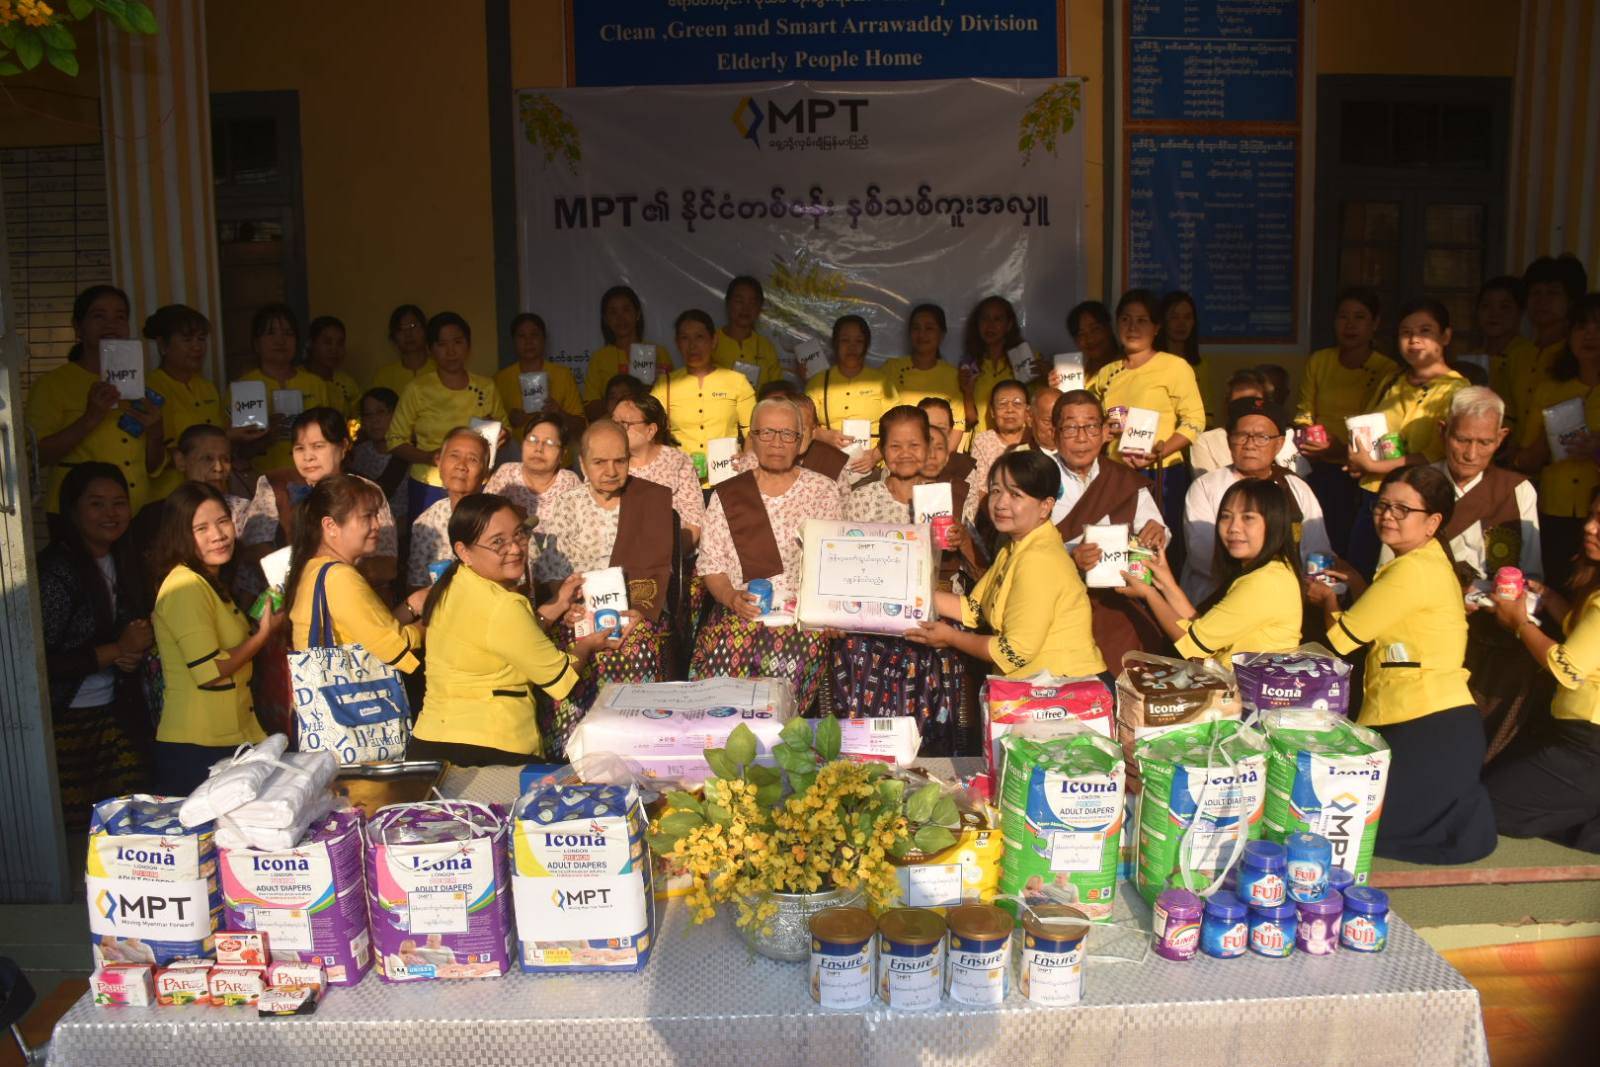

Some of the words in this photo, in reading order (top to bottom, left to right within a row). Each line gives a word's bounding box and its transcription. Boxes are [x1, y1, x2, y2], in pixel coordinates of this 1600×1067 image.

[600, 23, 656, 42] Clean
[734, 18, 769, 37] and
[776, 17, 836, 36] Smart
[843, 14, 954, 37] Arrawaddy
[961, 13, 1039, 31] Division
[717, 50, 786, 73] Elderly
[796, 49, 858, 72] People
[865, 48, 923, 66] Home
[768, 98, 868, 134] MPT
[242, 400, 264, 410] MPT
[1133, 430, 1154, 439] MPT
[1103, 551, 1128, 562] MPT
[596, 592, 620, 605] MPT
[1261, 682, 1302, 698] Icona
[1061, 780, 1118, 794] Icona
[1060, 808, 1083, 816] ADULT
[1085, 807, 1115, 815] DIAPERS
[545, 832, 607, 847] Icona
[117, 846, 176, 866] Icona
[253, 855, 310, 871] Icona
[413, 856, 472, 872] Icona
[547, 861, 571, 870] ADULT
[573, 861, 608, 870] DIAPERS
[280, 884, 312, 892] DIAPERS
[440, 883, 473, 892] DIAPERS
[567, 888, 611, 906] MPT
[120, 893, 191, 921] MPT
[821, 955, 866, 969] Ensure
[890, 957, 934, 972] Ensure
[960, 953, 1003, 967] Ensure
[1034, 953, 1077, 967] Ensure
